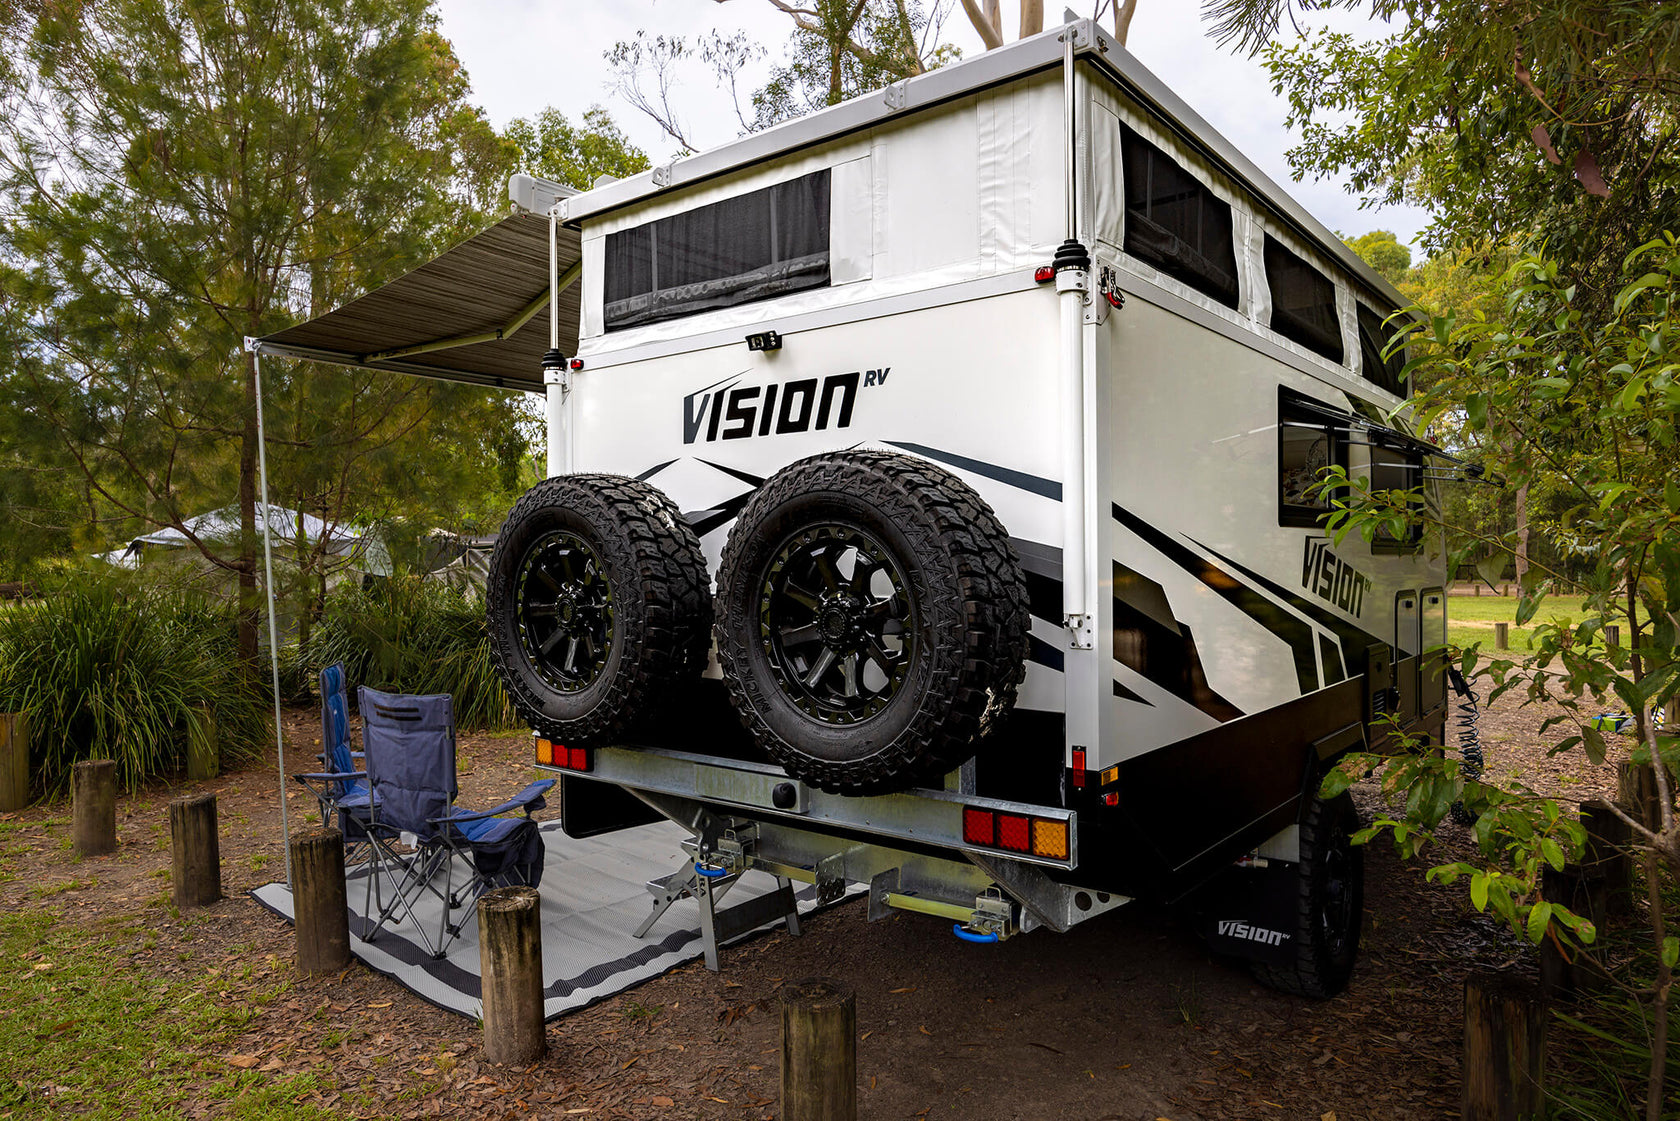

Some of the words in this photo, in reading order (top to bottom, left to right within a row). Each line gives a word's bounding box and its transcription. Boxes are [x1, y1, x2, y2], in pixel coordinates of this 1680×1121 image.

[683, 371, 860, 445] VISION
[863, 367, 891, 388] RV
[1302, 535, 1365, 619] VISION
[734, 642, 773, 715] MICKEY
[1218, 920, 1283, 946] VISION
